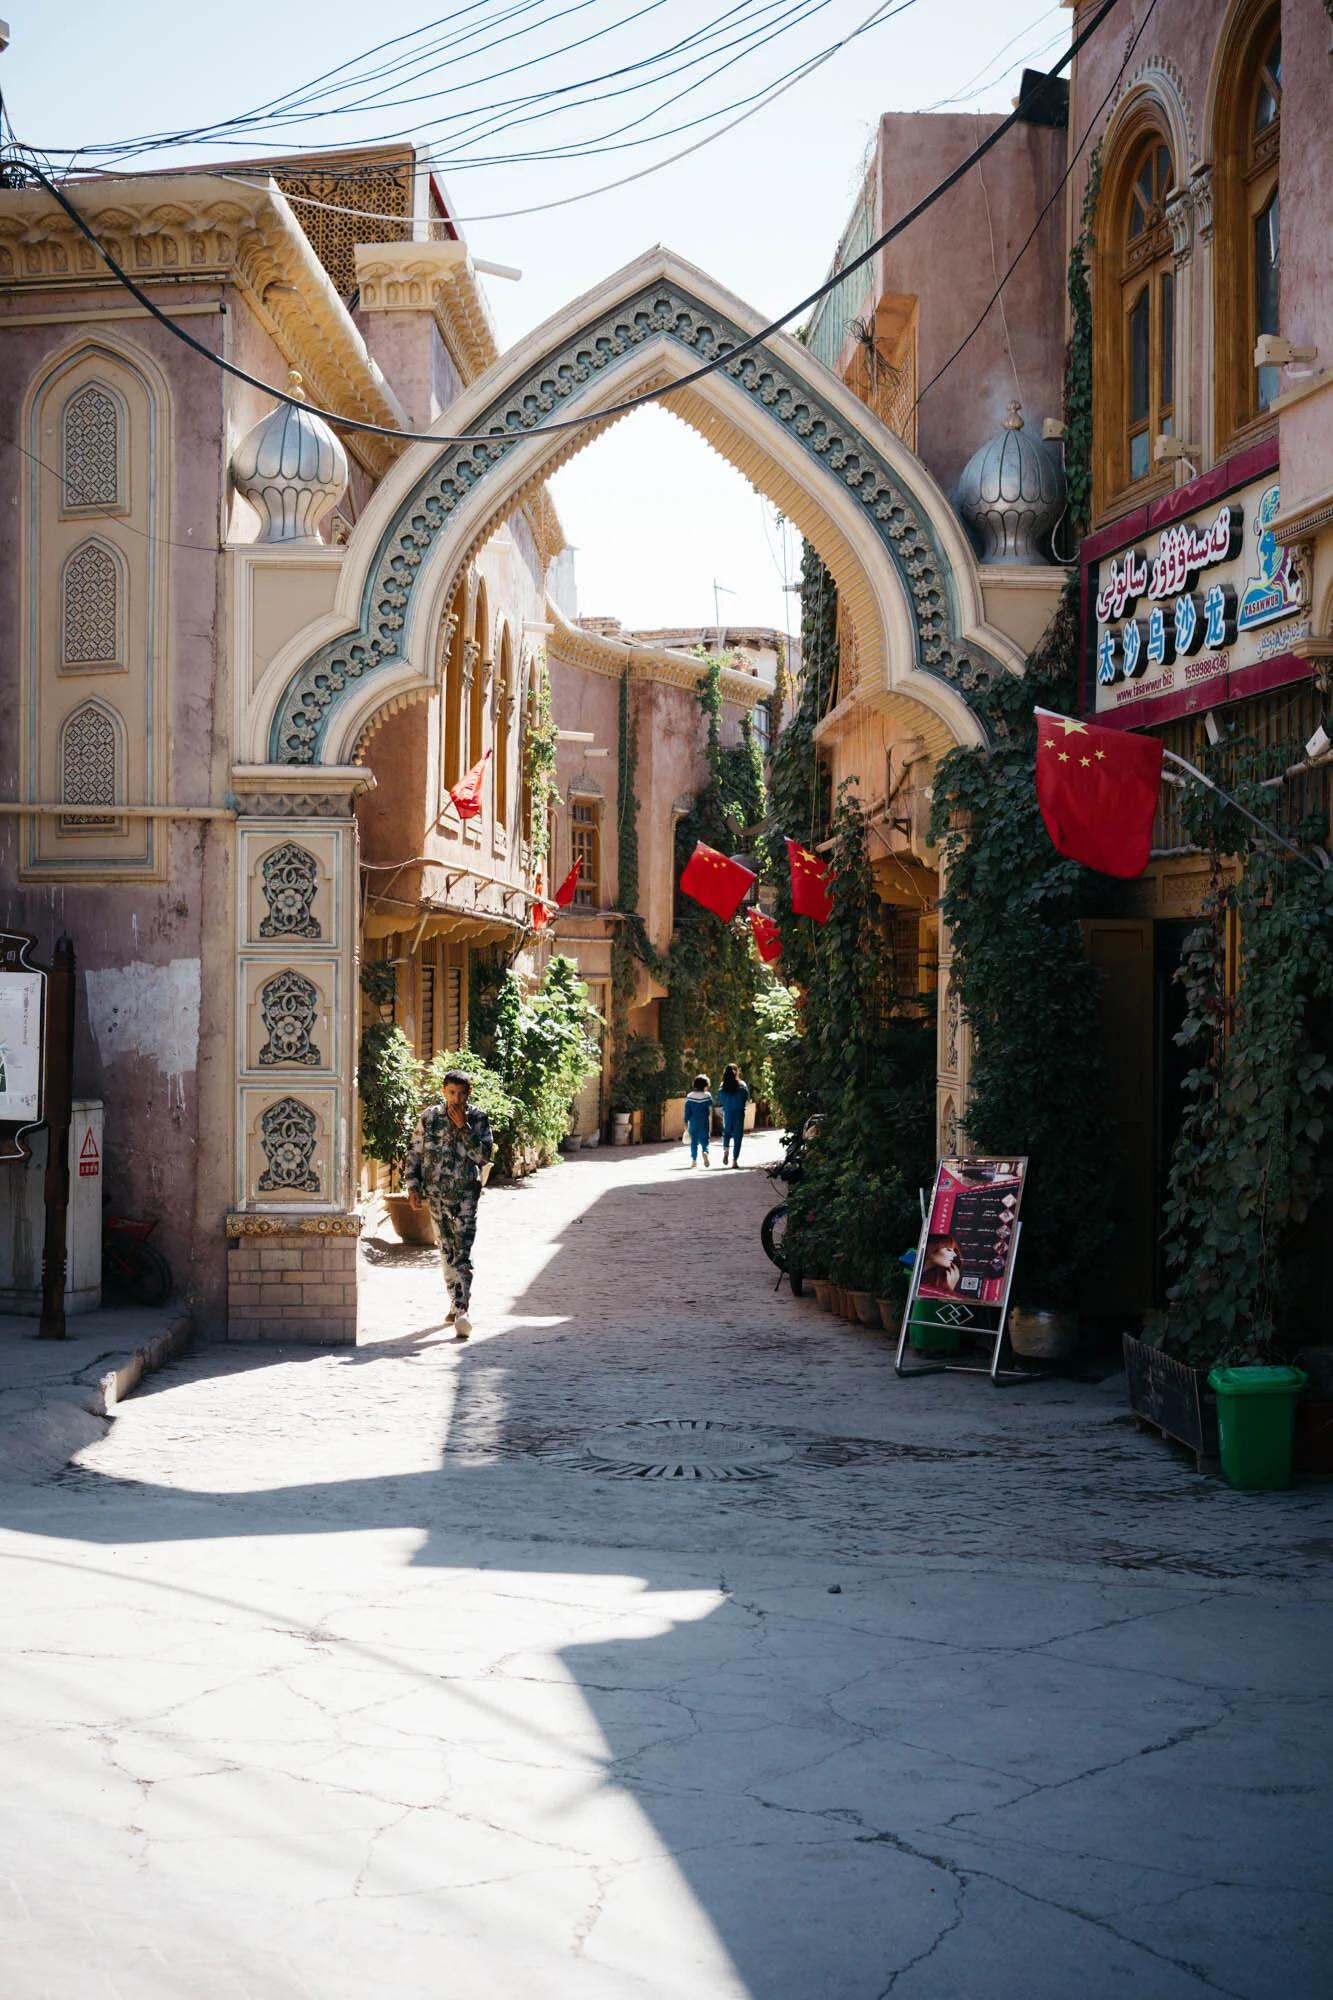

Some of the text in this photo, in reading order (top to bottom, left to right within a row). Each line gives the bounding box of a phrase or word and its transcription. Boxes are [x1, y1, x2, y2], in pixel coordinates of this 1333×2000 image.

[1244, 593, 1279, 616] TASAWWUR
[1116, 655, 1227, 702] www.tasawwurbiz 15599884346
